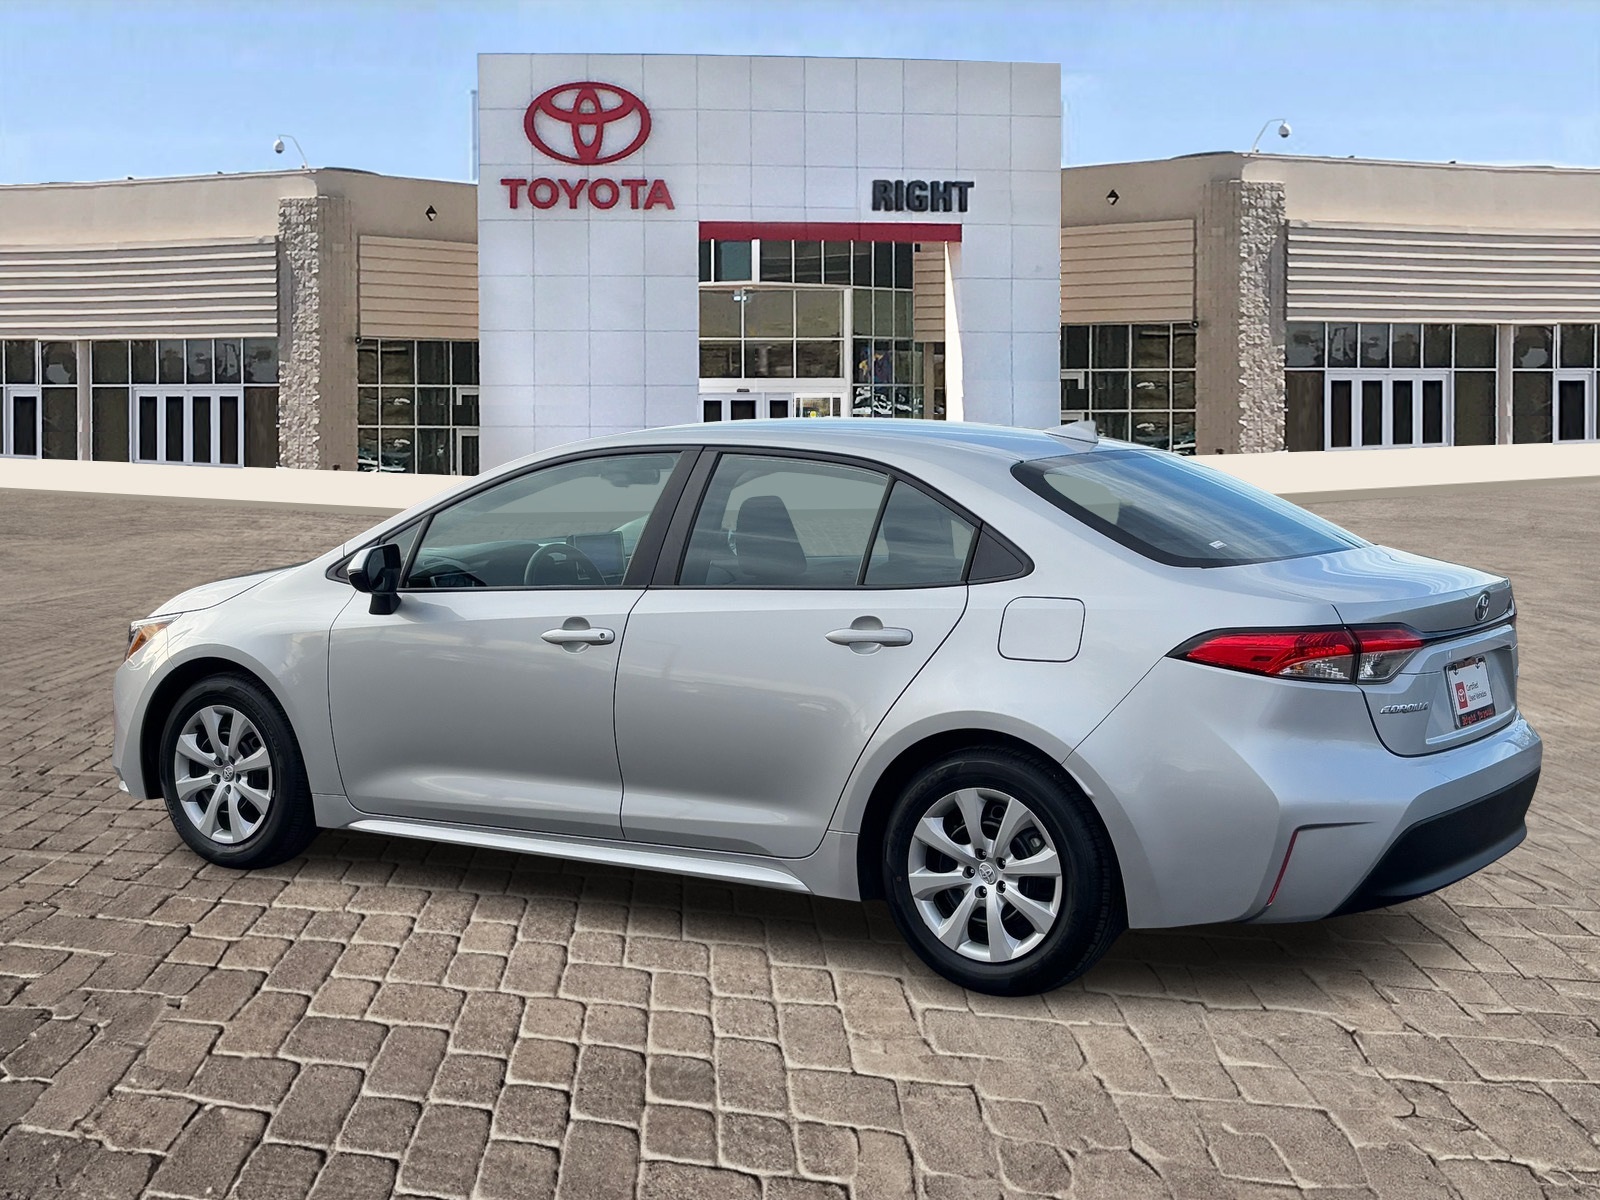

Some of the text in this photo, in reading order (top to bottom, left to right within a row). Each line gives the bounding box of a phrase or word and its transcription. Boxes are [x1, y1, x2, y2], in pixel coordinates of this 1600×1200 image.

[500, 178, 675, 210] TOYOTA
[872, 179, 975, 212] RIGHT
[1380, 702, 1429, 714] COROLLA
